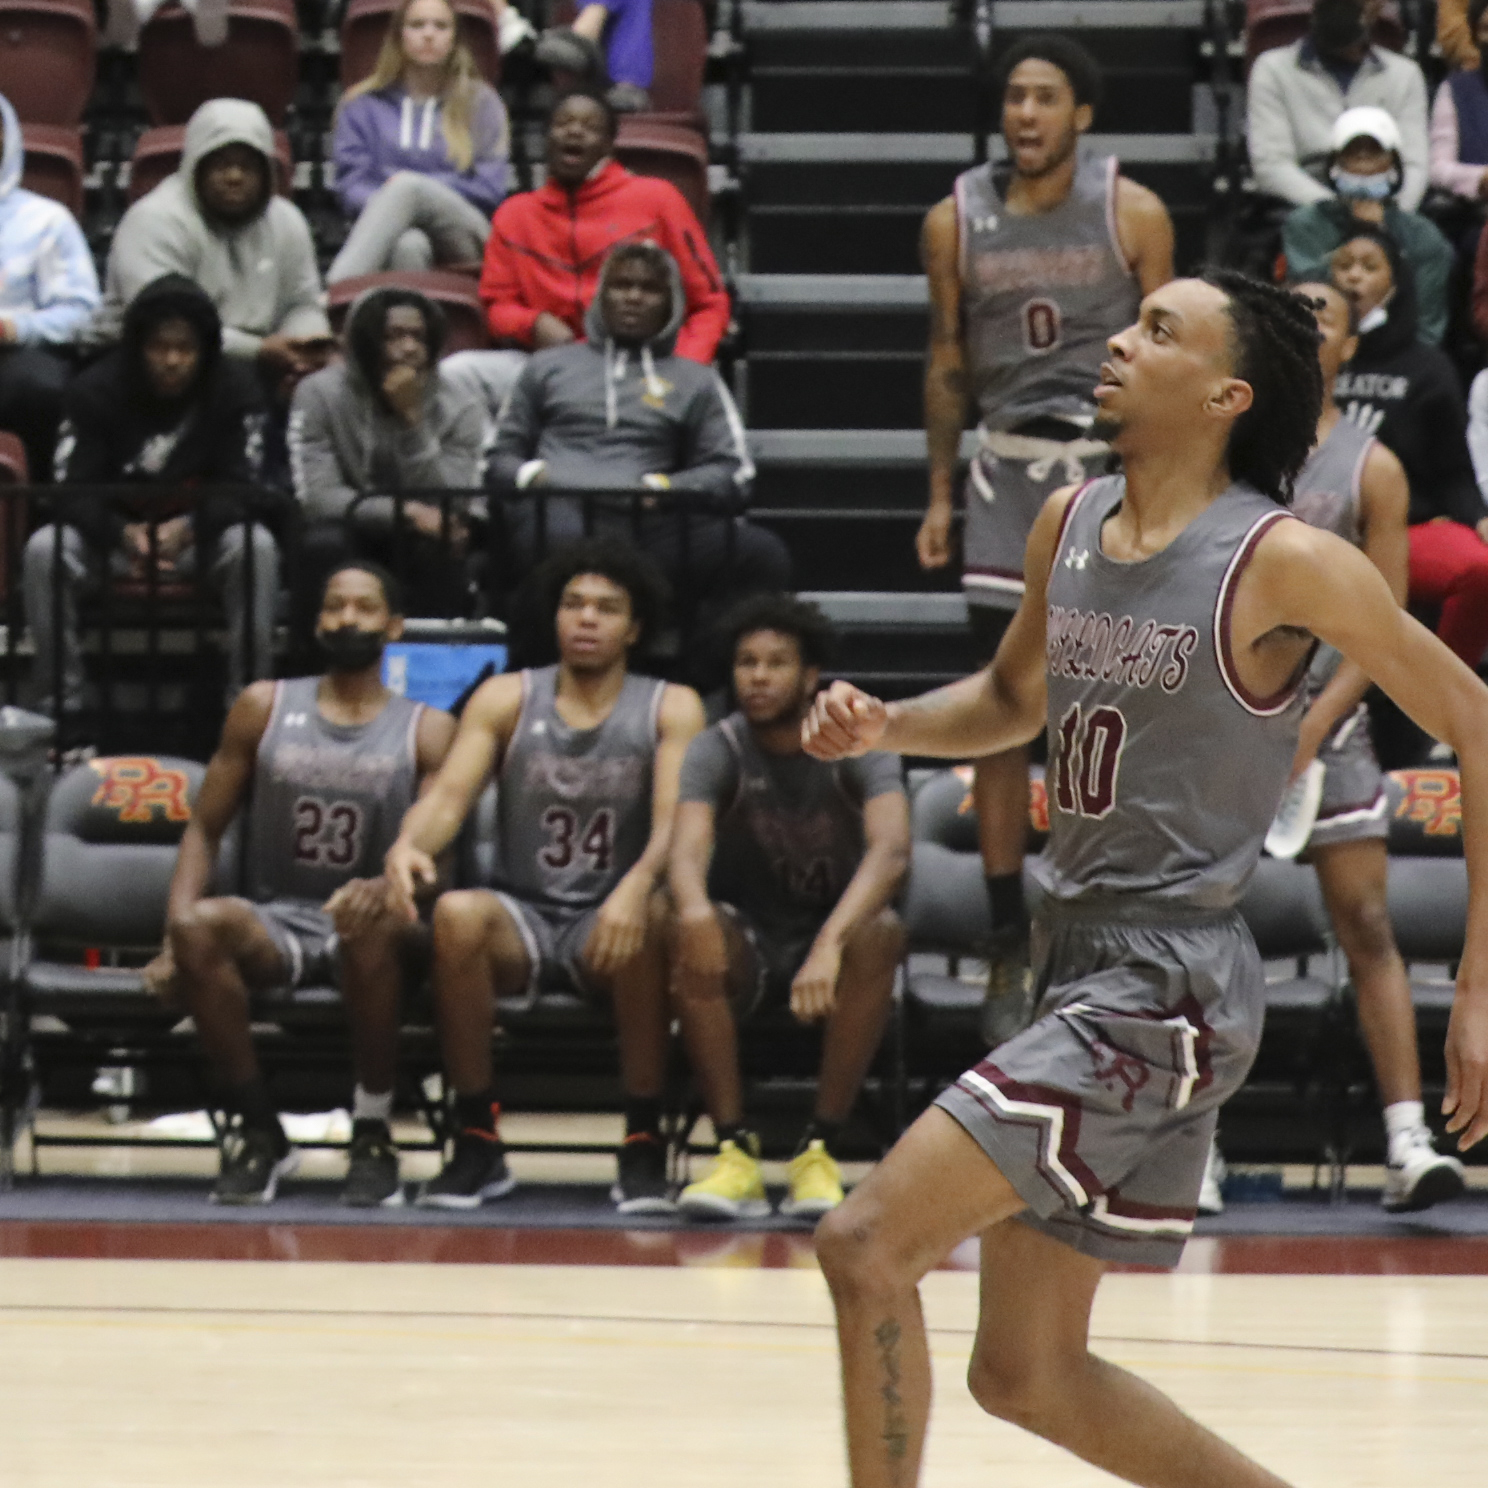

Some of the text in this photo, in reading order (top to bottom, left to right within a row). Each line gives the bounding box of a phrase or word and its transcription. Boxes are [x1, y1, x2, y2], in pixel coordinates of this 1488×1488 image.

[1021, 297, 1061, 356] 0
[1054, 701, 1128, 820] 10
[292, 795, 364, 868] 23
[537, 808, 618, 873] 34
